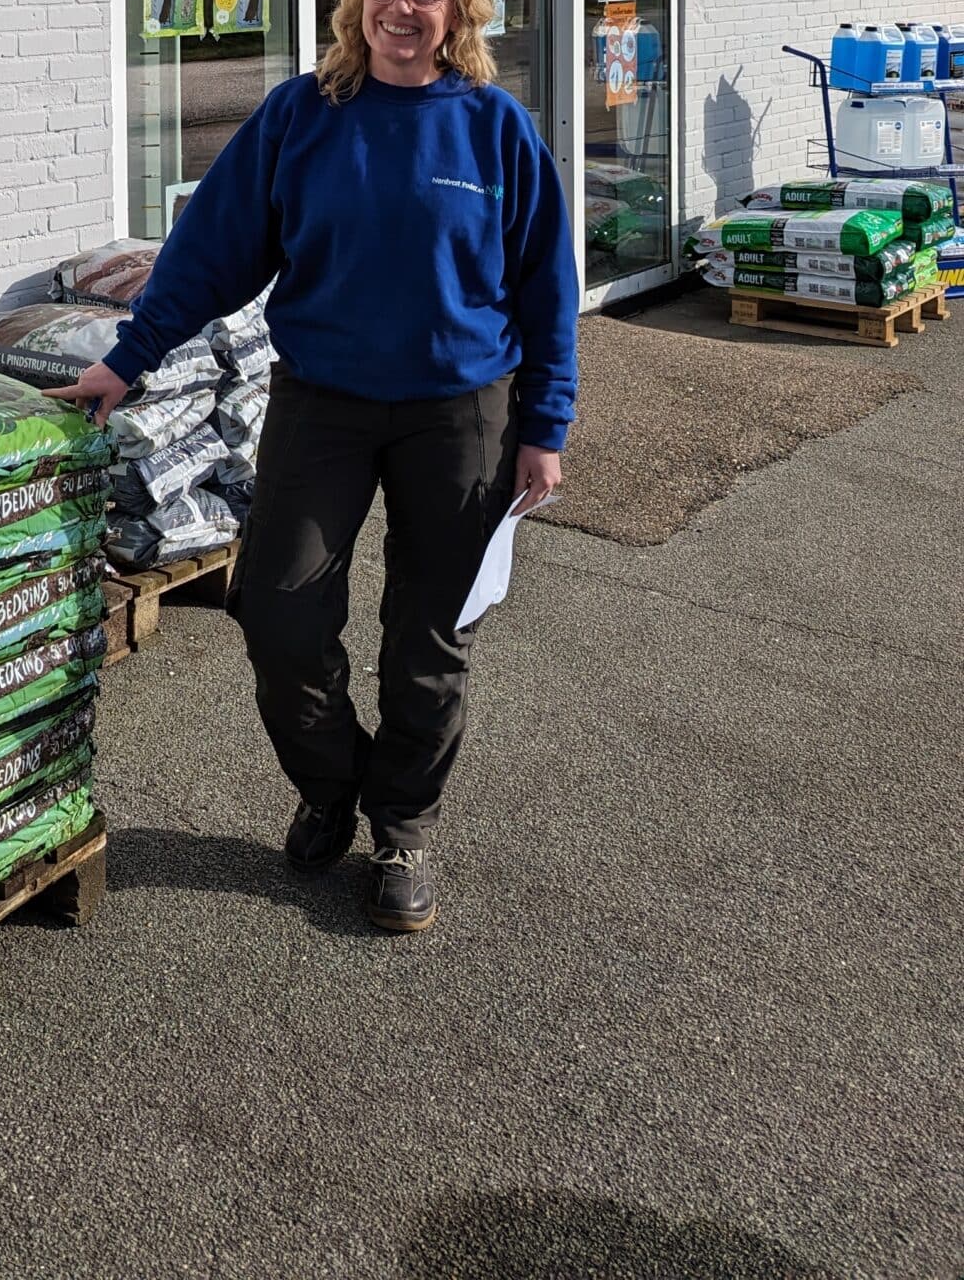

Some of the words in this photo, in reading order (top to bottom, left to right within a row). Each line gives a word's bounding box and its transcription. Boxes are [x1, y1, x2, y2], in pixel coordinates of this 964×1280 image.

[786, 192, 812, 202] ADULT
[726, 233, 751, 245] ADULT
[738, 254, 765, 264] ADULT
[738, 273, 765, 285] ADULT
[1, 354, 6, 364] L
[6, 354, 47, 372] PINDSTRUP
[62, 478, 74, 492] 50
